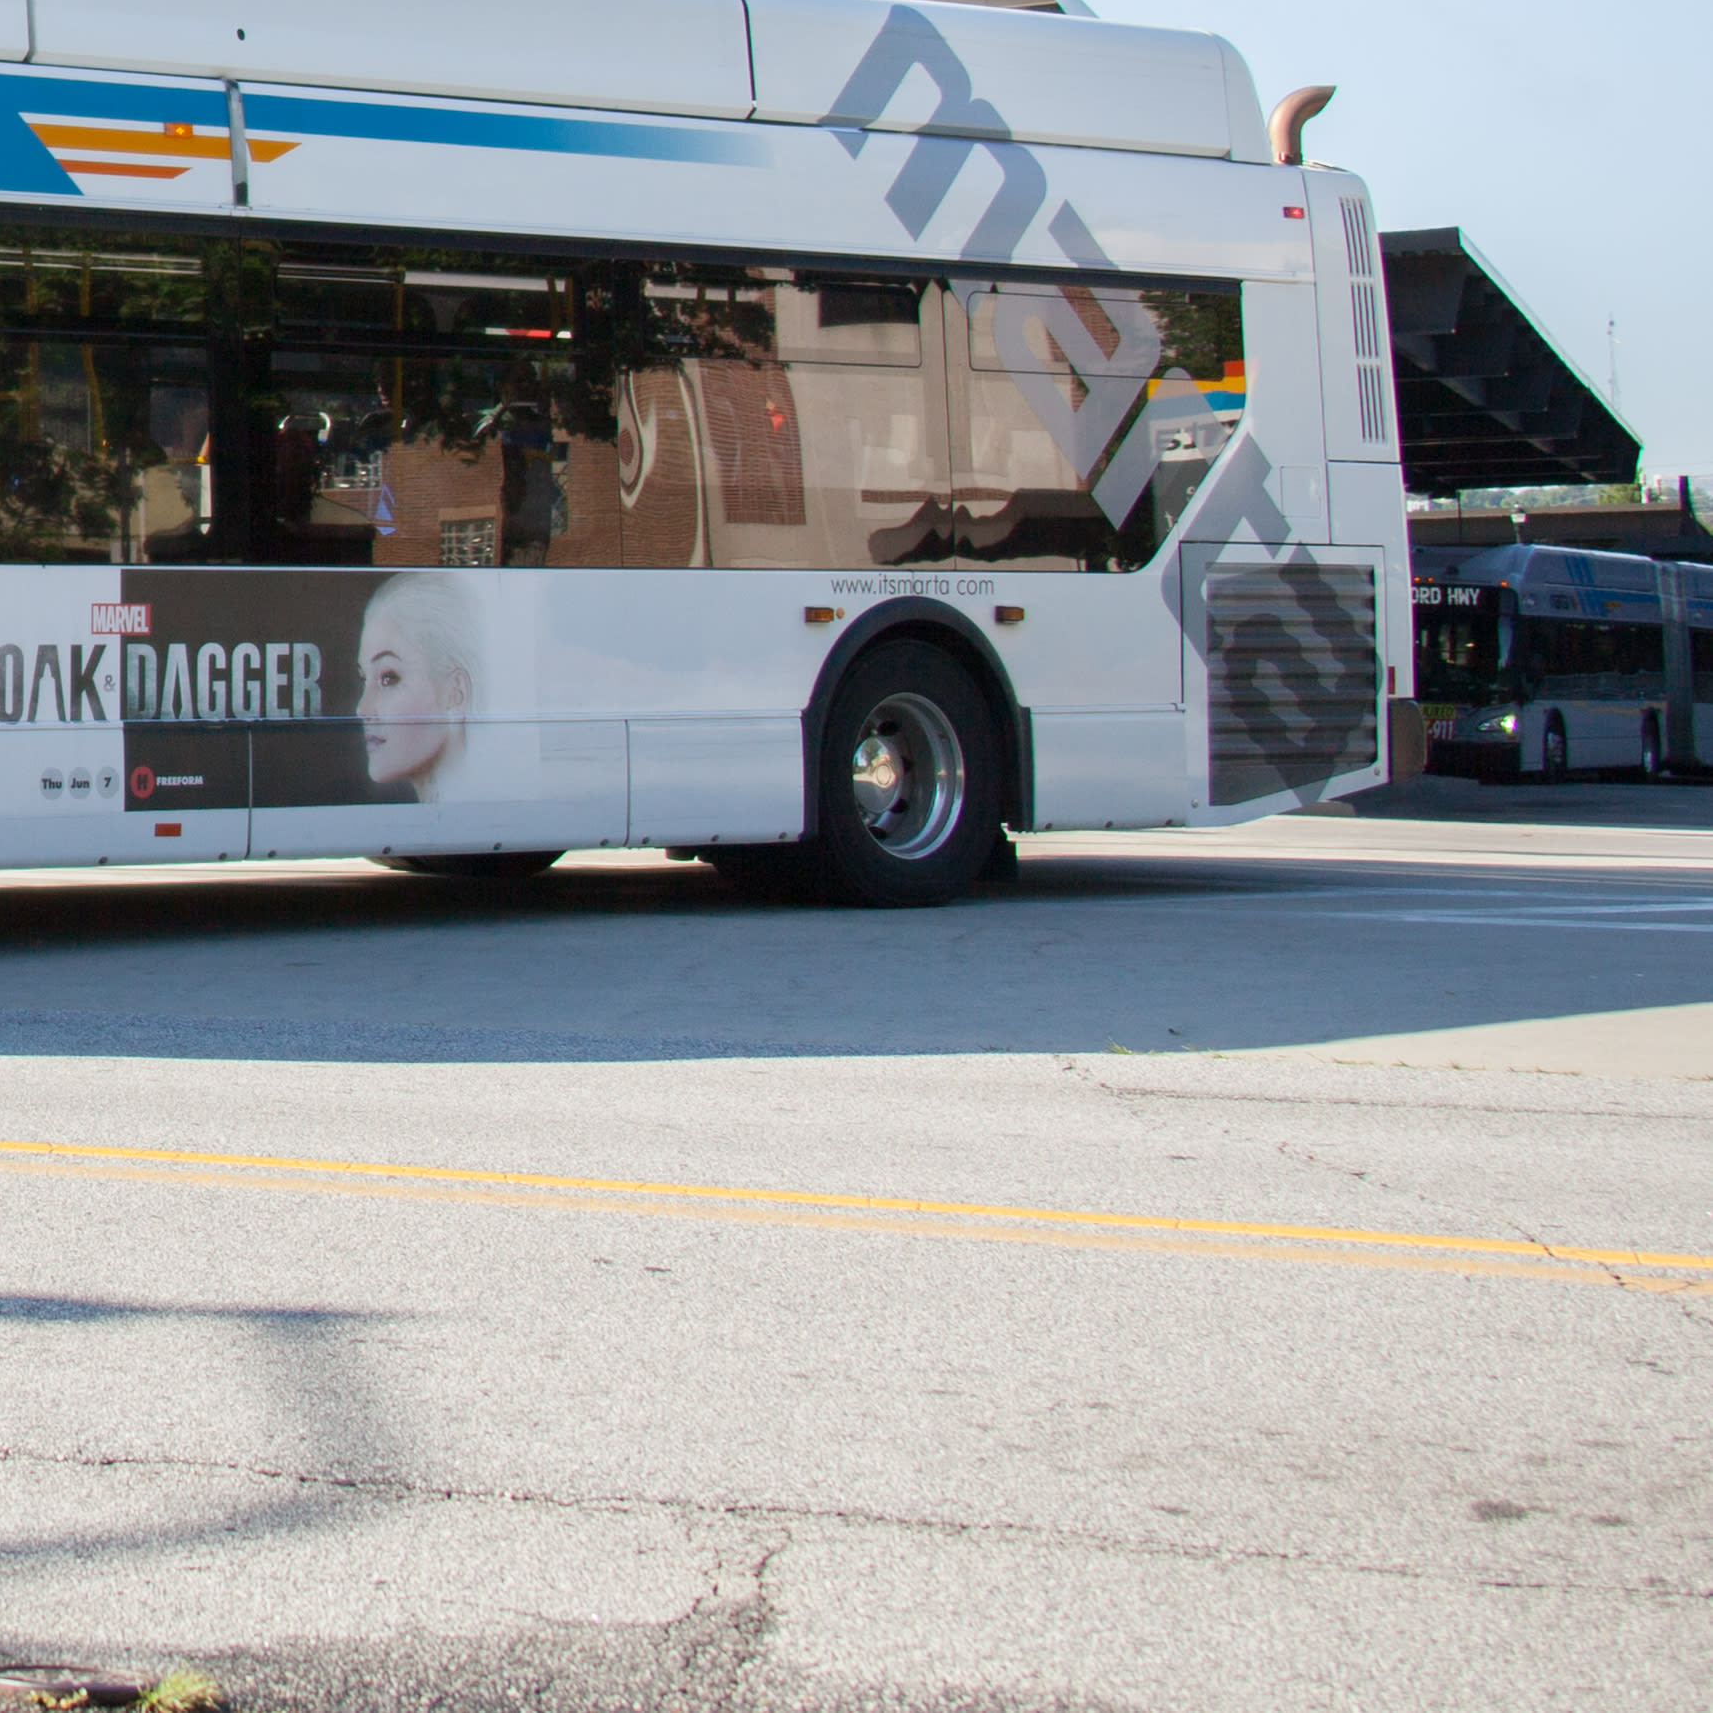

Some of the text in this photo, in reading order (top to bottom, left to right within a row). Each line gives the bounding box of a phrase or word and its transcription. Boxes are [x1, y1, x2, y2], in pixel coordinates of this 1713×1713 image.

[1447, 587, 1481, 606] HWY
[92, 605, 150, 633] MARVEL
[103, 674, 117, 693] &
[127, 642, 323, 721] DAGGER
[41, 777, 112, 789] Thu Jun 7
[156, 775, 204, 786] FREEFORM
